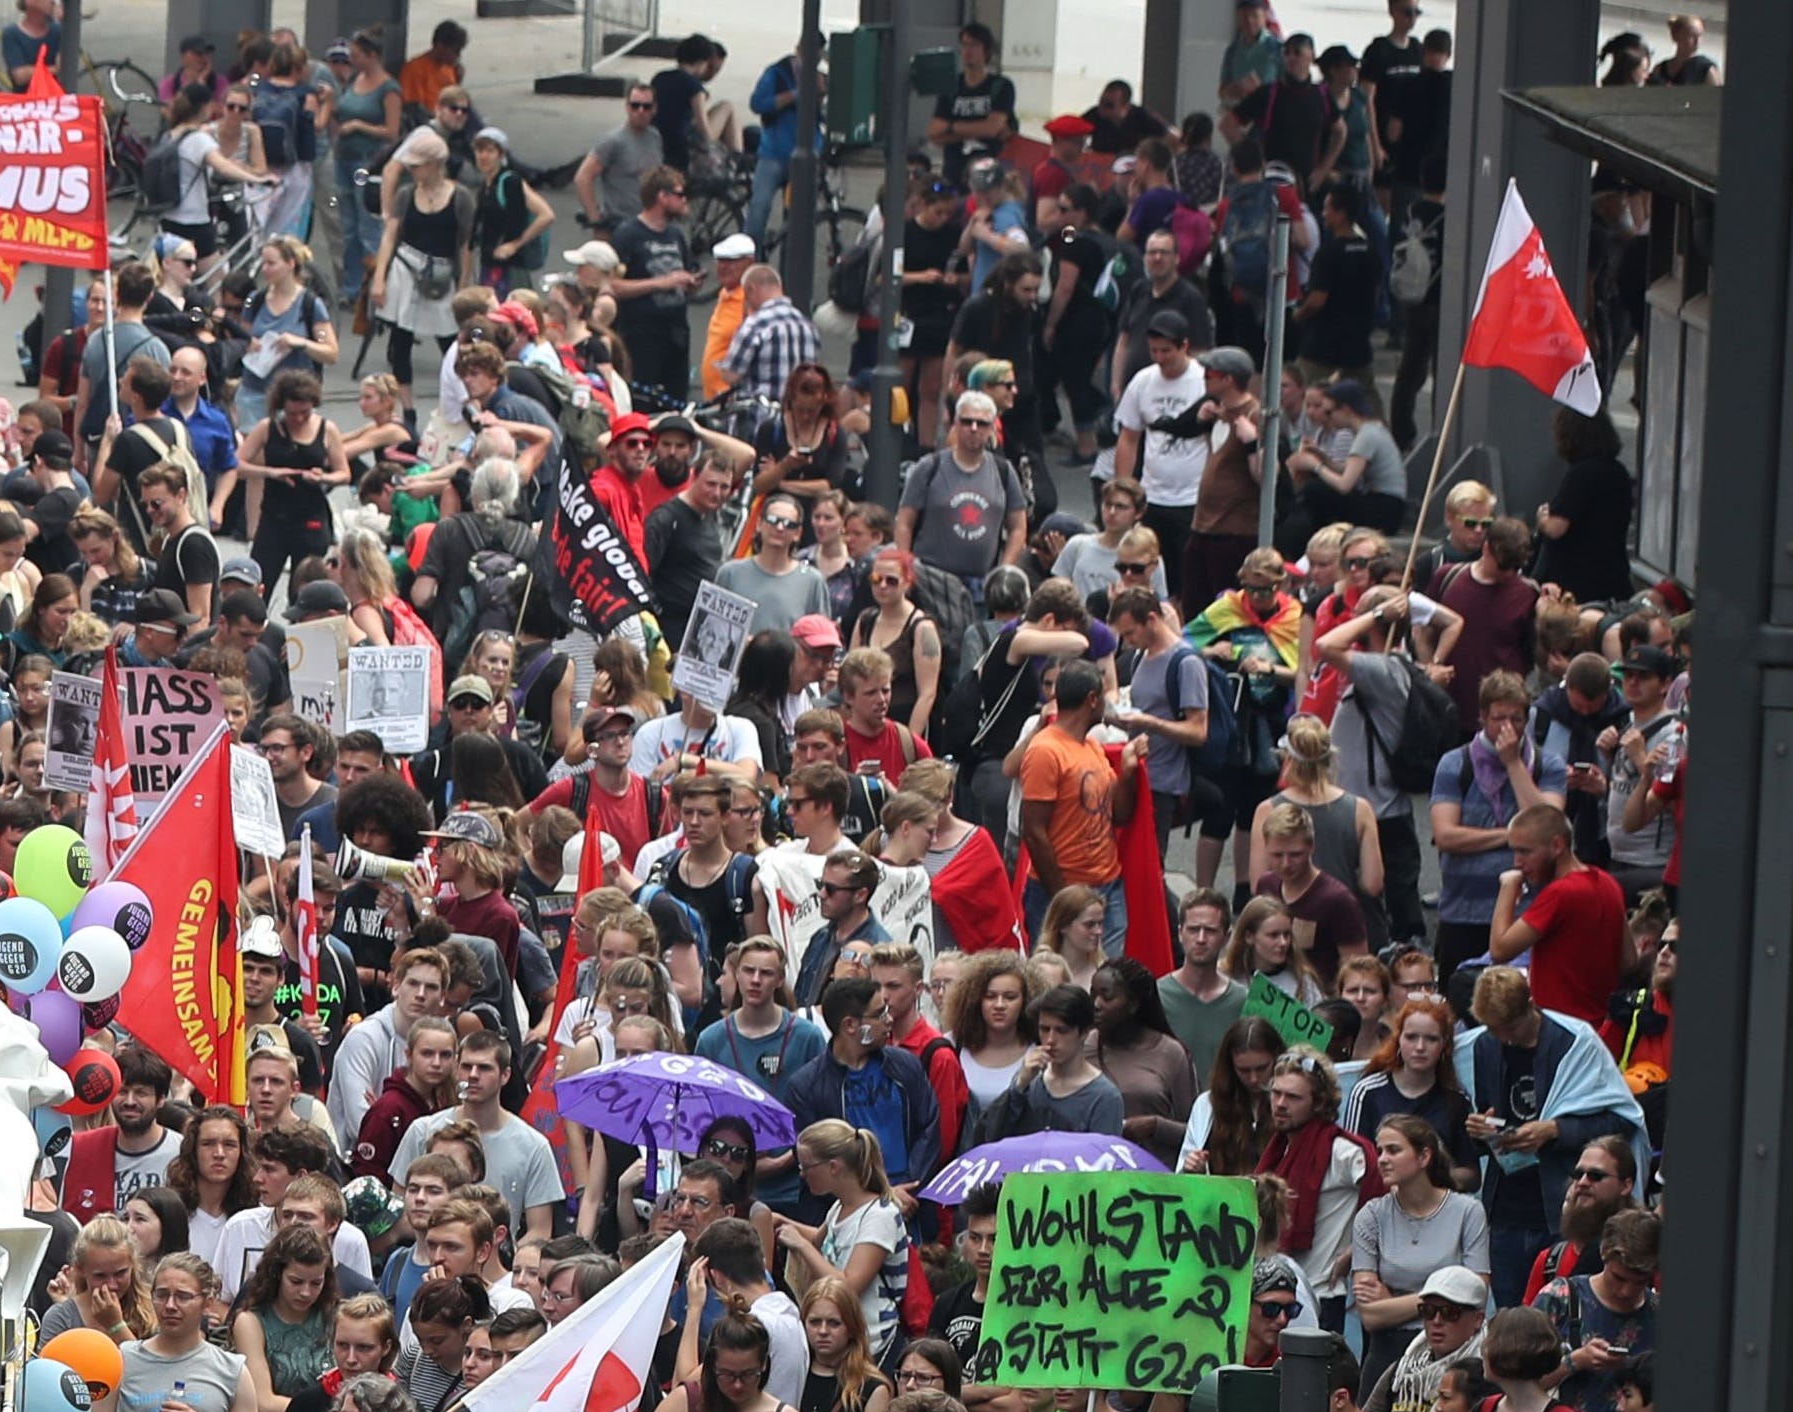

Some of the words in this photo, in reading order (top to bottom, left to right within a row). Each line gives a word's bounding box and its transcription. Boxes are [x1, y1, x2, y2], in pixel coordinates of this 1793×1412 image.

[701, 590, 750, 625] WANTED
[354, 653, 424, 671] WANTED
[135, 724, 196, 757] IST
[172, 878, 215, 1067] GEMEINSAM
[1260, 985, 1325, 1040] STOP
[1006, 1185, 1255, 1272] WOHLSTAND
[1004, 1321, 1119, 1378] STATT
